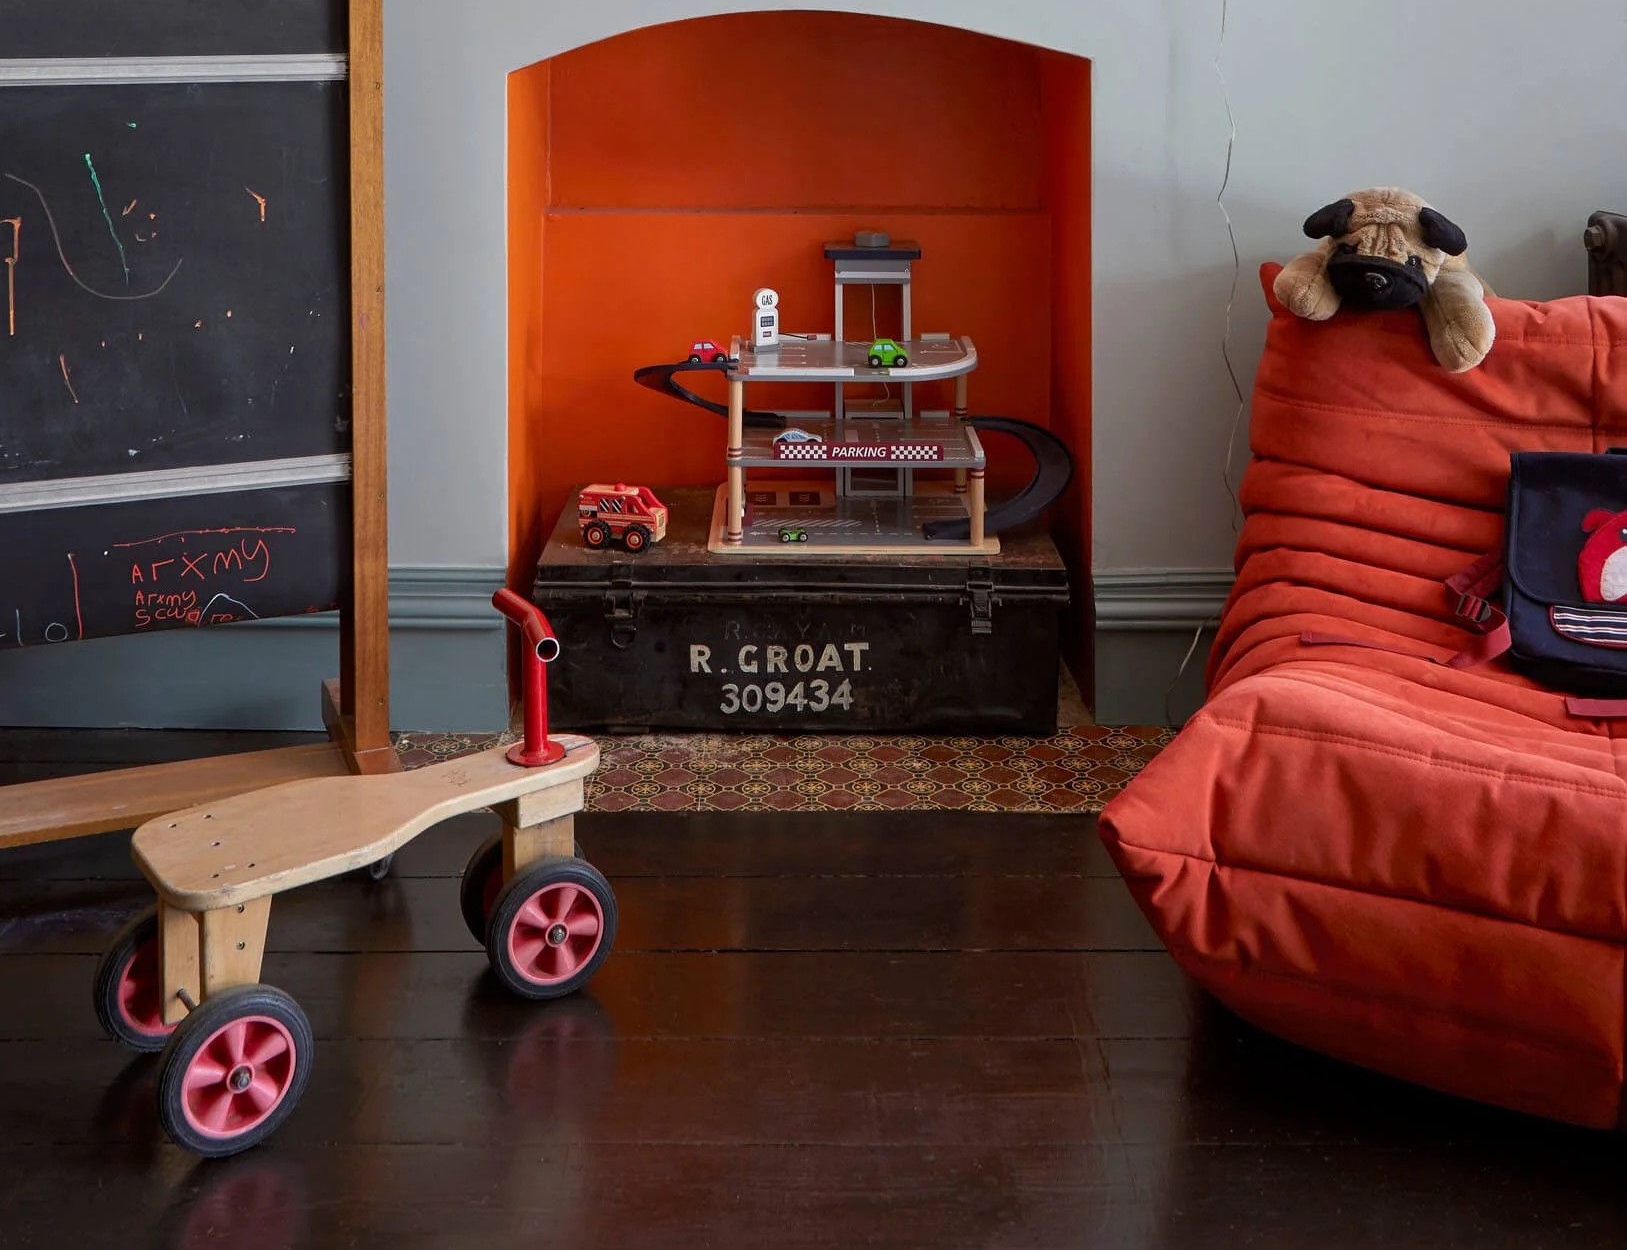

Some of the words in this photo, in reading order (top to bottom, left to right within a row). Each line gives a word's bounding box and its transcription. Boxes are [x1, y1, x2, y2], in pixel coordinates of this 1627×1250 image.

[761, 294, 773, 306] GAS
[832, 446, 887, 458] PARKING
[720, 678, 855, 715] 309434
